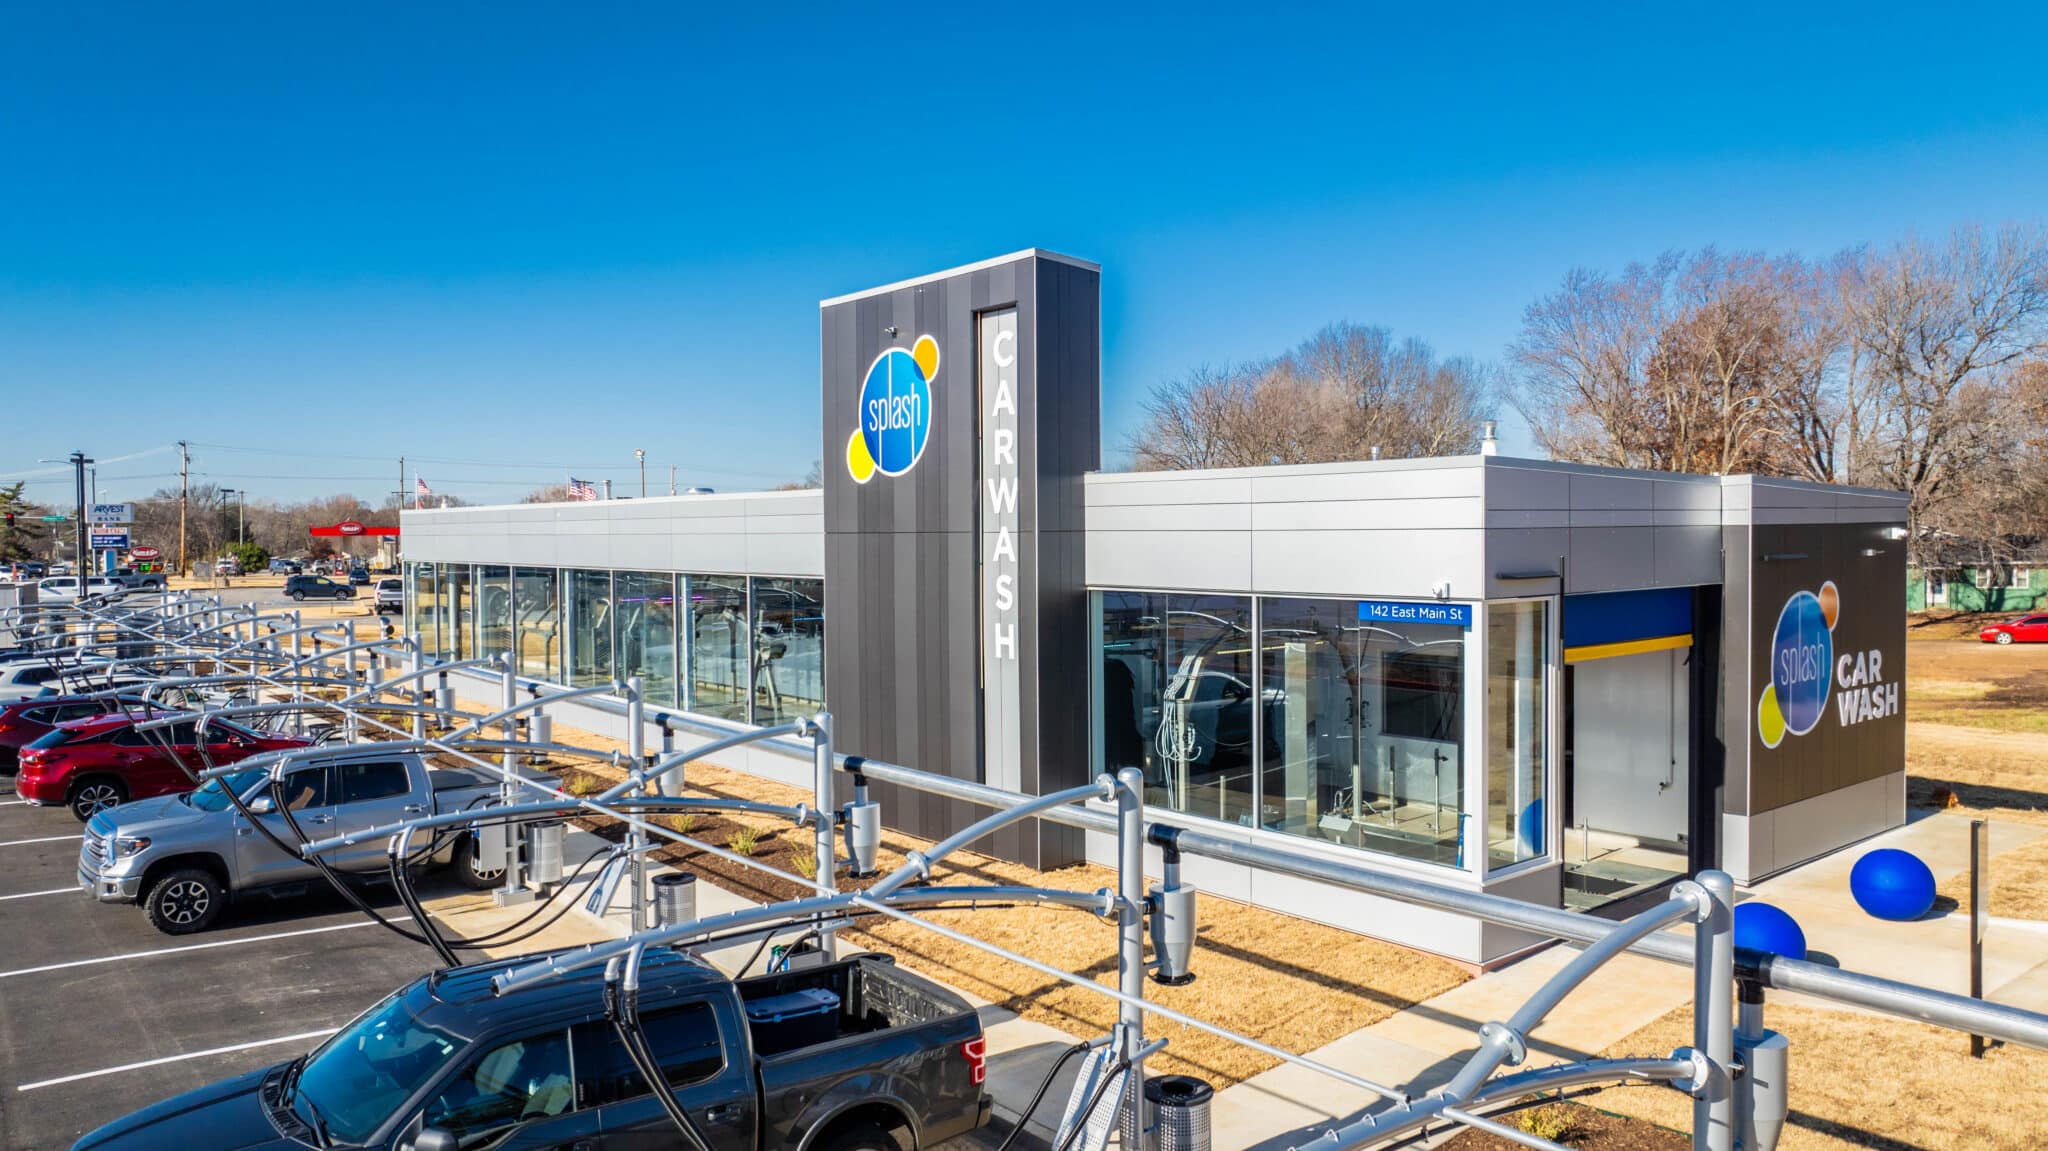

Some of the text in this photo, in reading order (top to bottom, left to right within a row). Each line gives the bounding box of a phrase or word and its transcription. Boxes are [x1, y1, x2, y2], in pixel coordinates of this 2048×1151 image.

[94, 505, 124, 514] ARVEST
[1370, 605, 1463, 620] 142 East Main St
[1837, 649, 1882, 689] CAR
[1837, 682, 1898, 727] WASH
